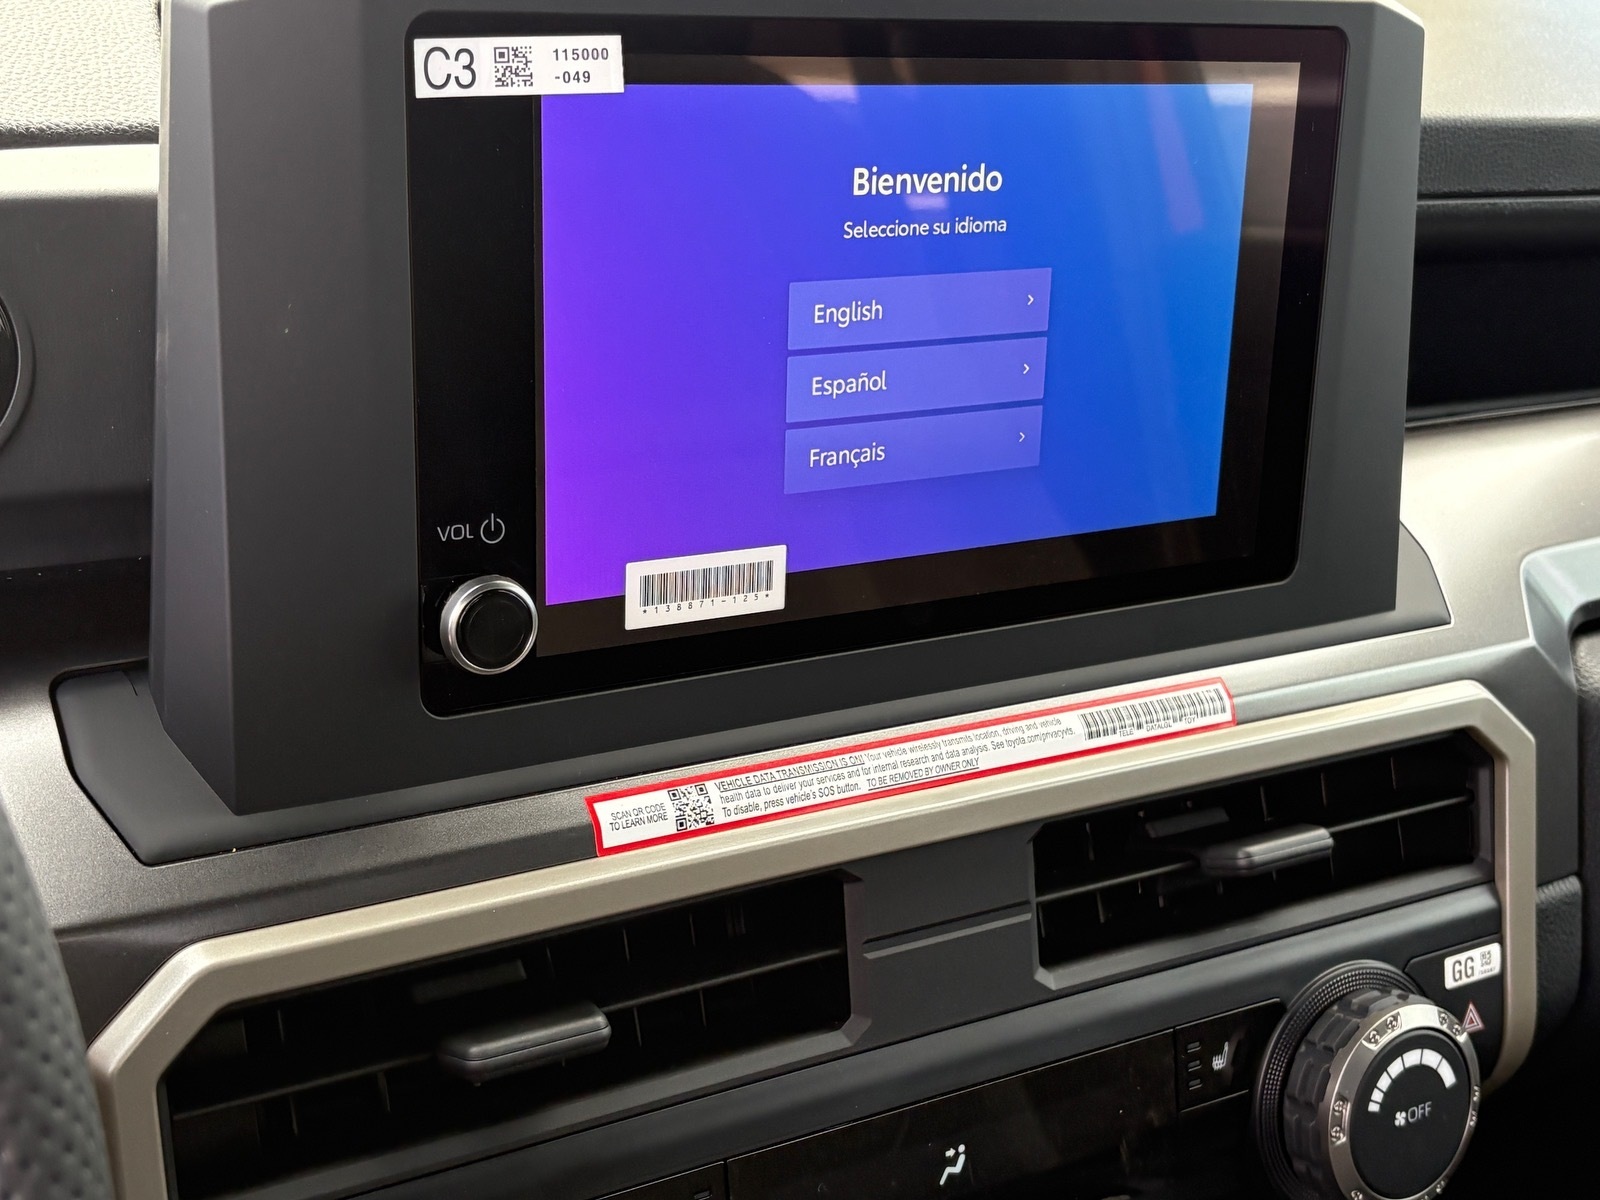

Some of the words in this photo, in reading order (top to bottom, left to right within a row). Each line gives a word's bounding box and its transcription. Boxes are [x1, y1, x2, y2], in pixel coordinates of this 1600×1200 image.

[552, 48, 609, 61] 115000
[423, 47, 476, 89] C3
[554, 70, 591, 84] -049
[852, 163, 1002, 196] Bienvenido
[843, 220, 929, 239] Seleccione
[932, 221, 950, 235] su
[955, 216, 1007, 234] idioma
[814, 300, 883, 328] English
[812, 370, 887, 399] Español
[809, 442, 886, 468] Français
[437, 523, 474, 541] VOL
[714, 776, 753, 791] VEHICLE
[753, 772, 776, 784] DATA
[776, 759, 838, 779] TRANSMISSION
[839, 758, 848, 766] IS
[864, 752, 881, 761] Your
[882, 747, 907, 758] vehicle
[908, 741, 942, 754] wirelessly
[942, 735, 973, 746] transmits
[1002, 725, 1025, 735] driving
[1025, 721, 1038, 731] and
[1039, 717, 1062, 728] vehicle
[719, 792, 744, 804] health
[745, 789, 761, 800] data
[762, 787, 771, 795] to
[772, 781, 797, 794] deliver
[798, 778, 814, 790] your
[816, 773, 845, 785] services
[847, 769, 860, 779] and
[862, 766, 871, 775] for
[872, 760, 898, 773] internal
[900, 755, 930, 768] research
[931, 752, 944, 762] and
[945, 749, 960, 759] data
[962, 743, 990, 756] analysis.
[991, 741, 1005, 750] See
[722, 807, 732, 818] To
[733, 801, 762, 815] disable,
[764, 798, 784, 812] press
[786, 790, 816, 804] vehicle's
[818, 786, 835, 798] SOS
[837, 783, 861, 794] button.
[866, 778, 877, 788] TO
[878, 775, 888, 785] BE
[889, 768, 923, 783] REMOVED
[924, 766, 934, 776] BY
[935, 761, 961, 774] OWNER
[961, 757, 979, 768] ONLY
[609, 821, 620, 831] TO
[621, 816, 646, 829] LEARN
[646, 811, 668, 824] MORE
[611, 810, 632, 821] SCAN
[645, 803, 666, 814] CODE
[1452, 956, 1475, 983] GG
[1407, 1101, 1432, 1123] OFF
